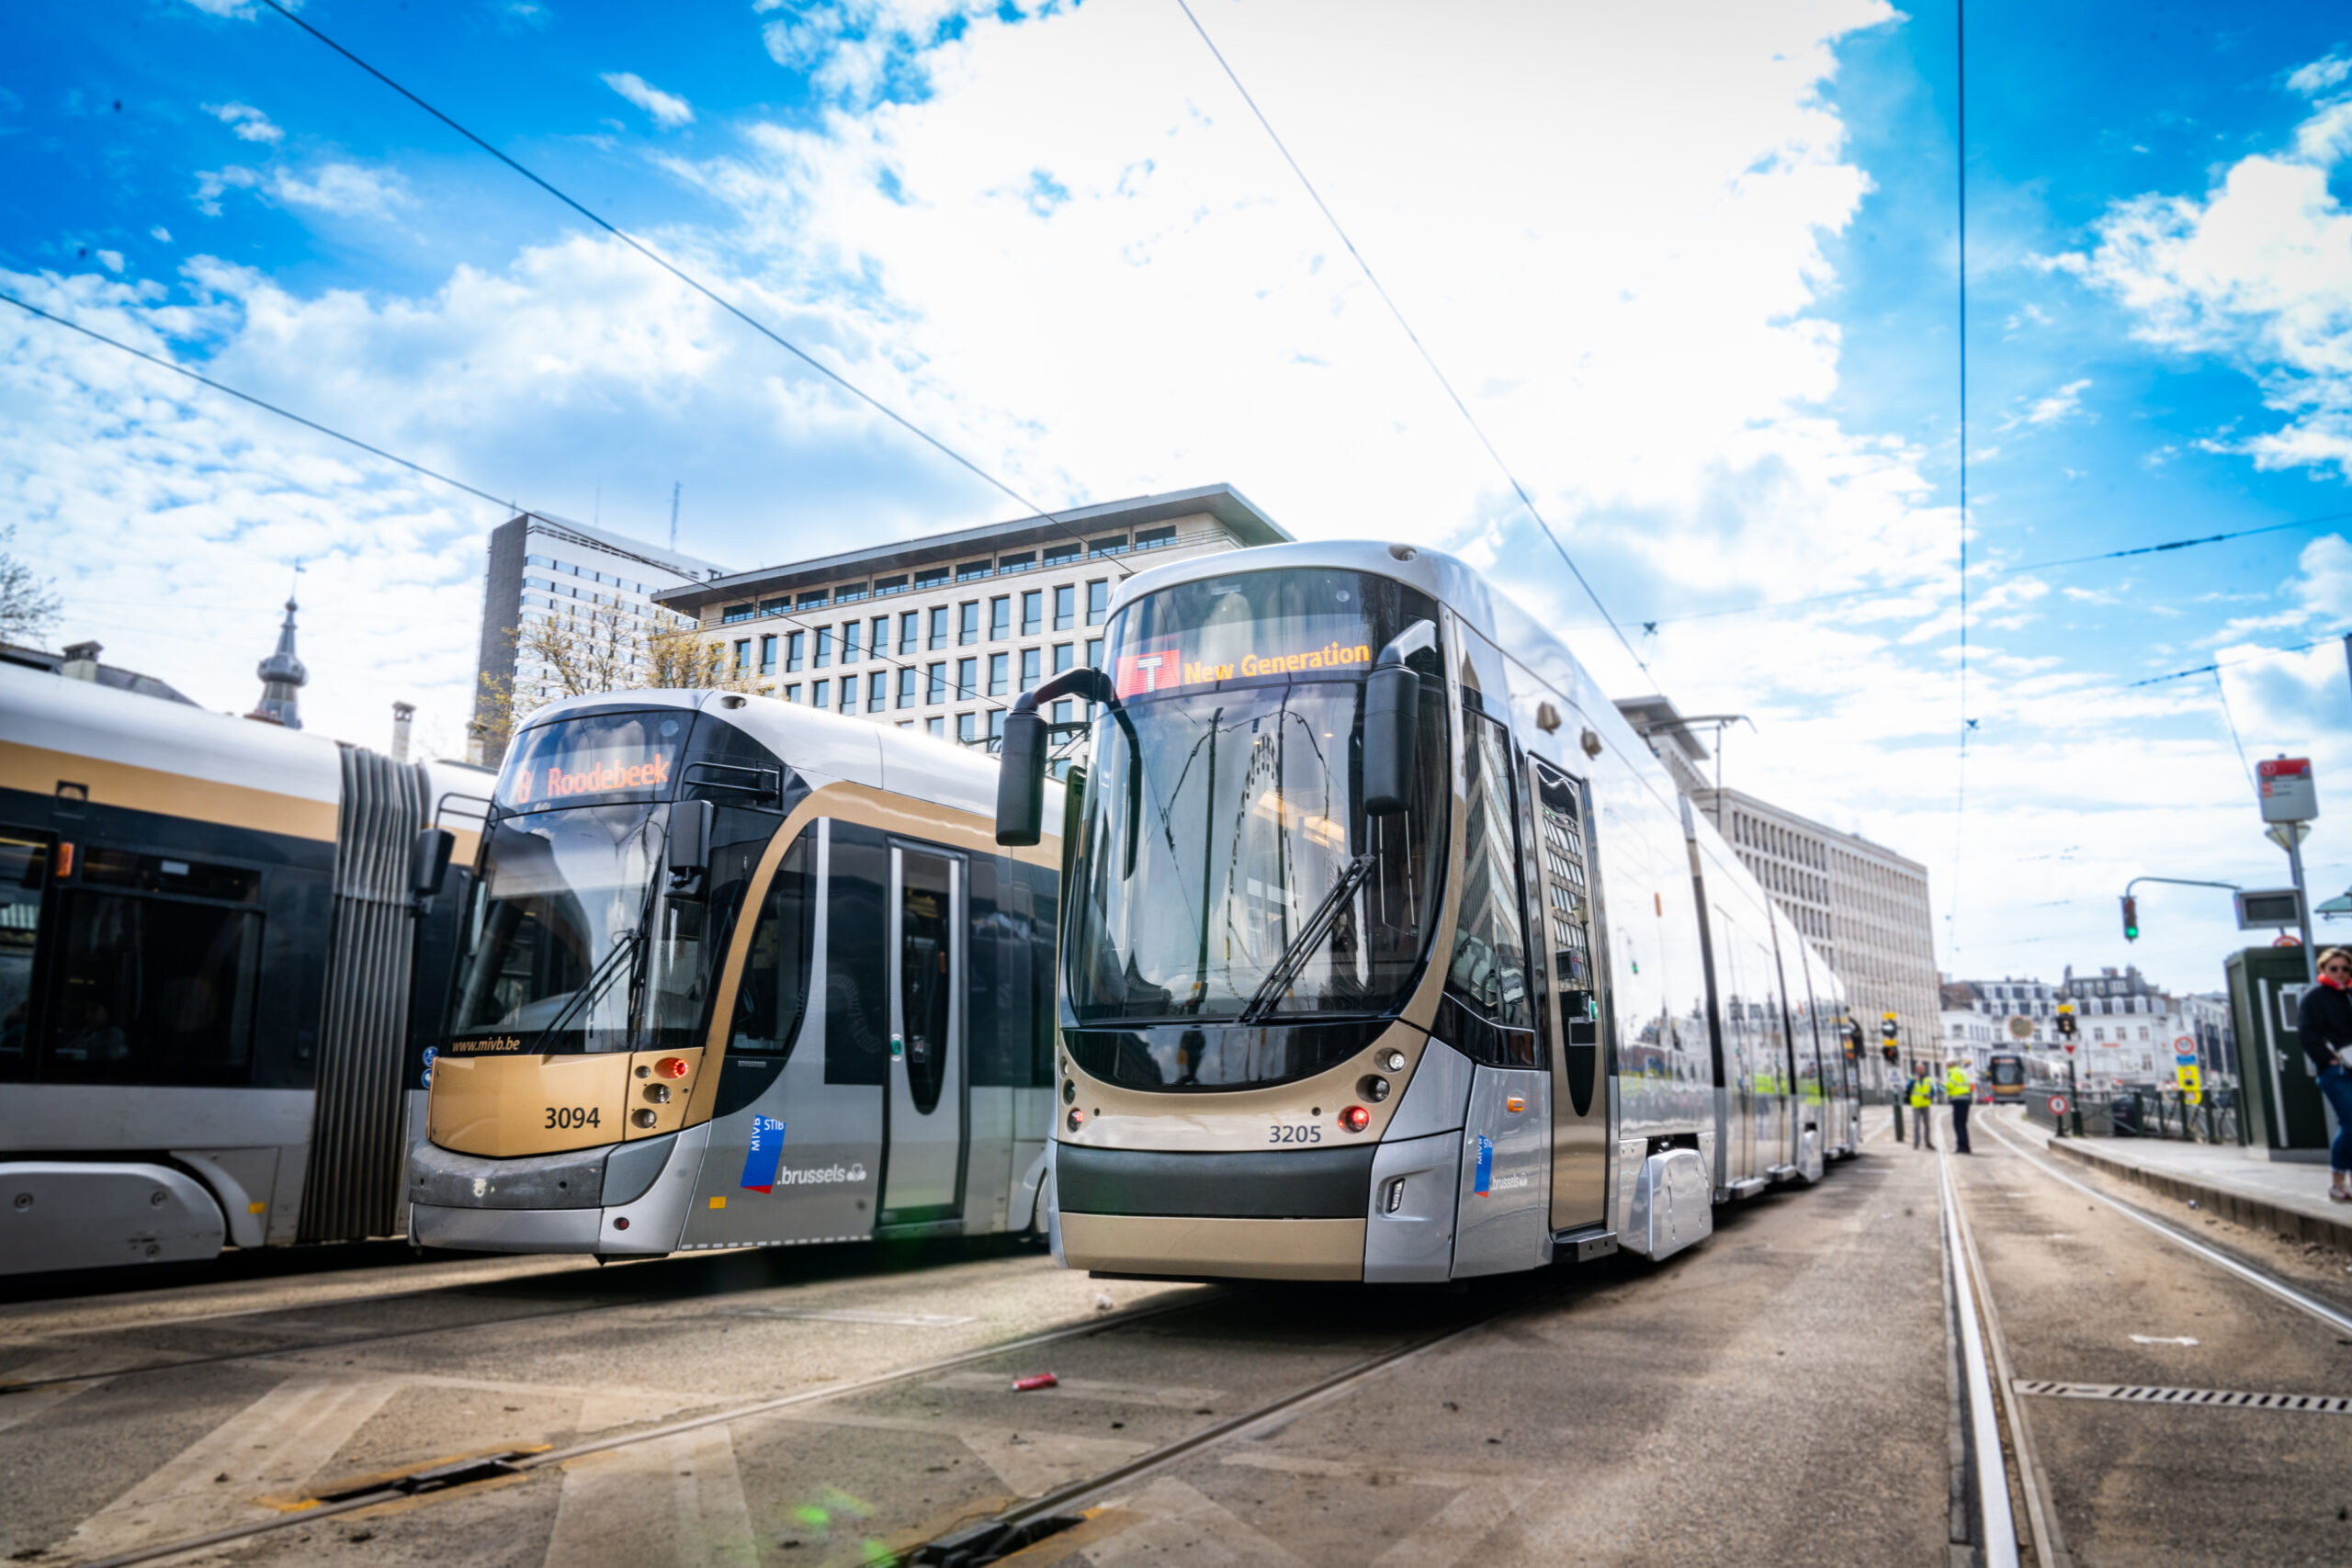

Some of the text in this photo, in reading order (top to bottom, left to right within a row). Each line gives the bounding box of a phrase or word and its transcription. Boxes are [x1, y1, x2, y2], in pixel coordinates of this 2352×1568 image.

[1137, 641, 1370, 693] T New Generation
[548, 753, 670, 797] Roodebeek
[452, 1035, 521, 1053] www.mivb.be
[544, 1107, 601, 1129] 3094
[1269, 1125, 1321, 1143] 3205
